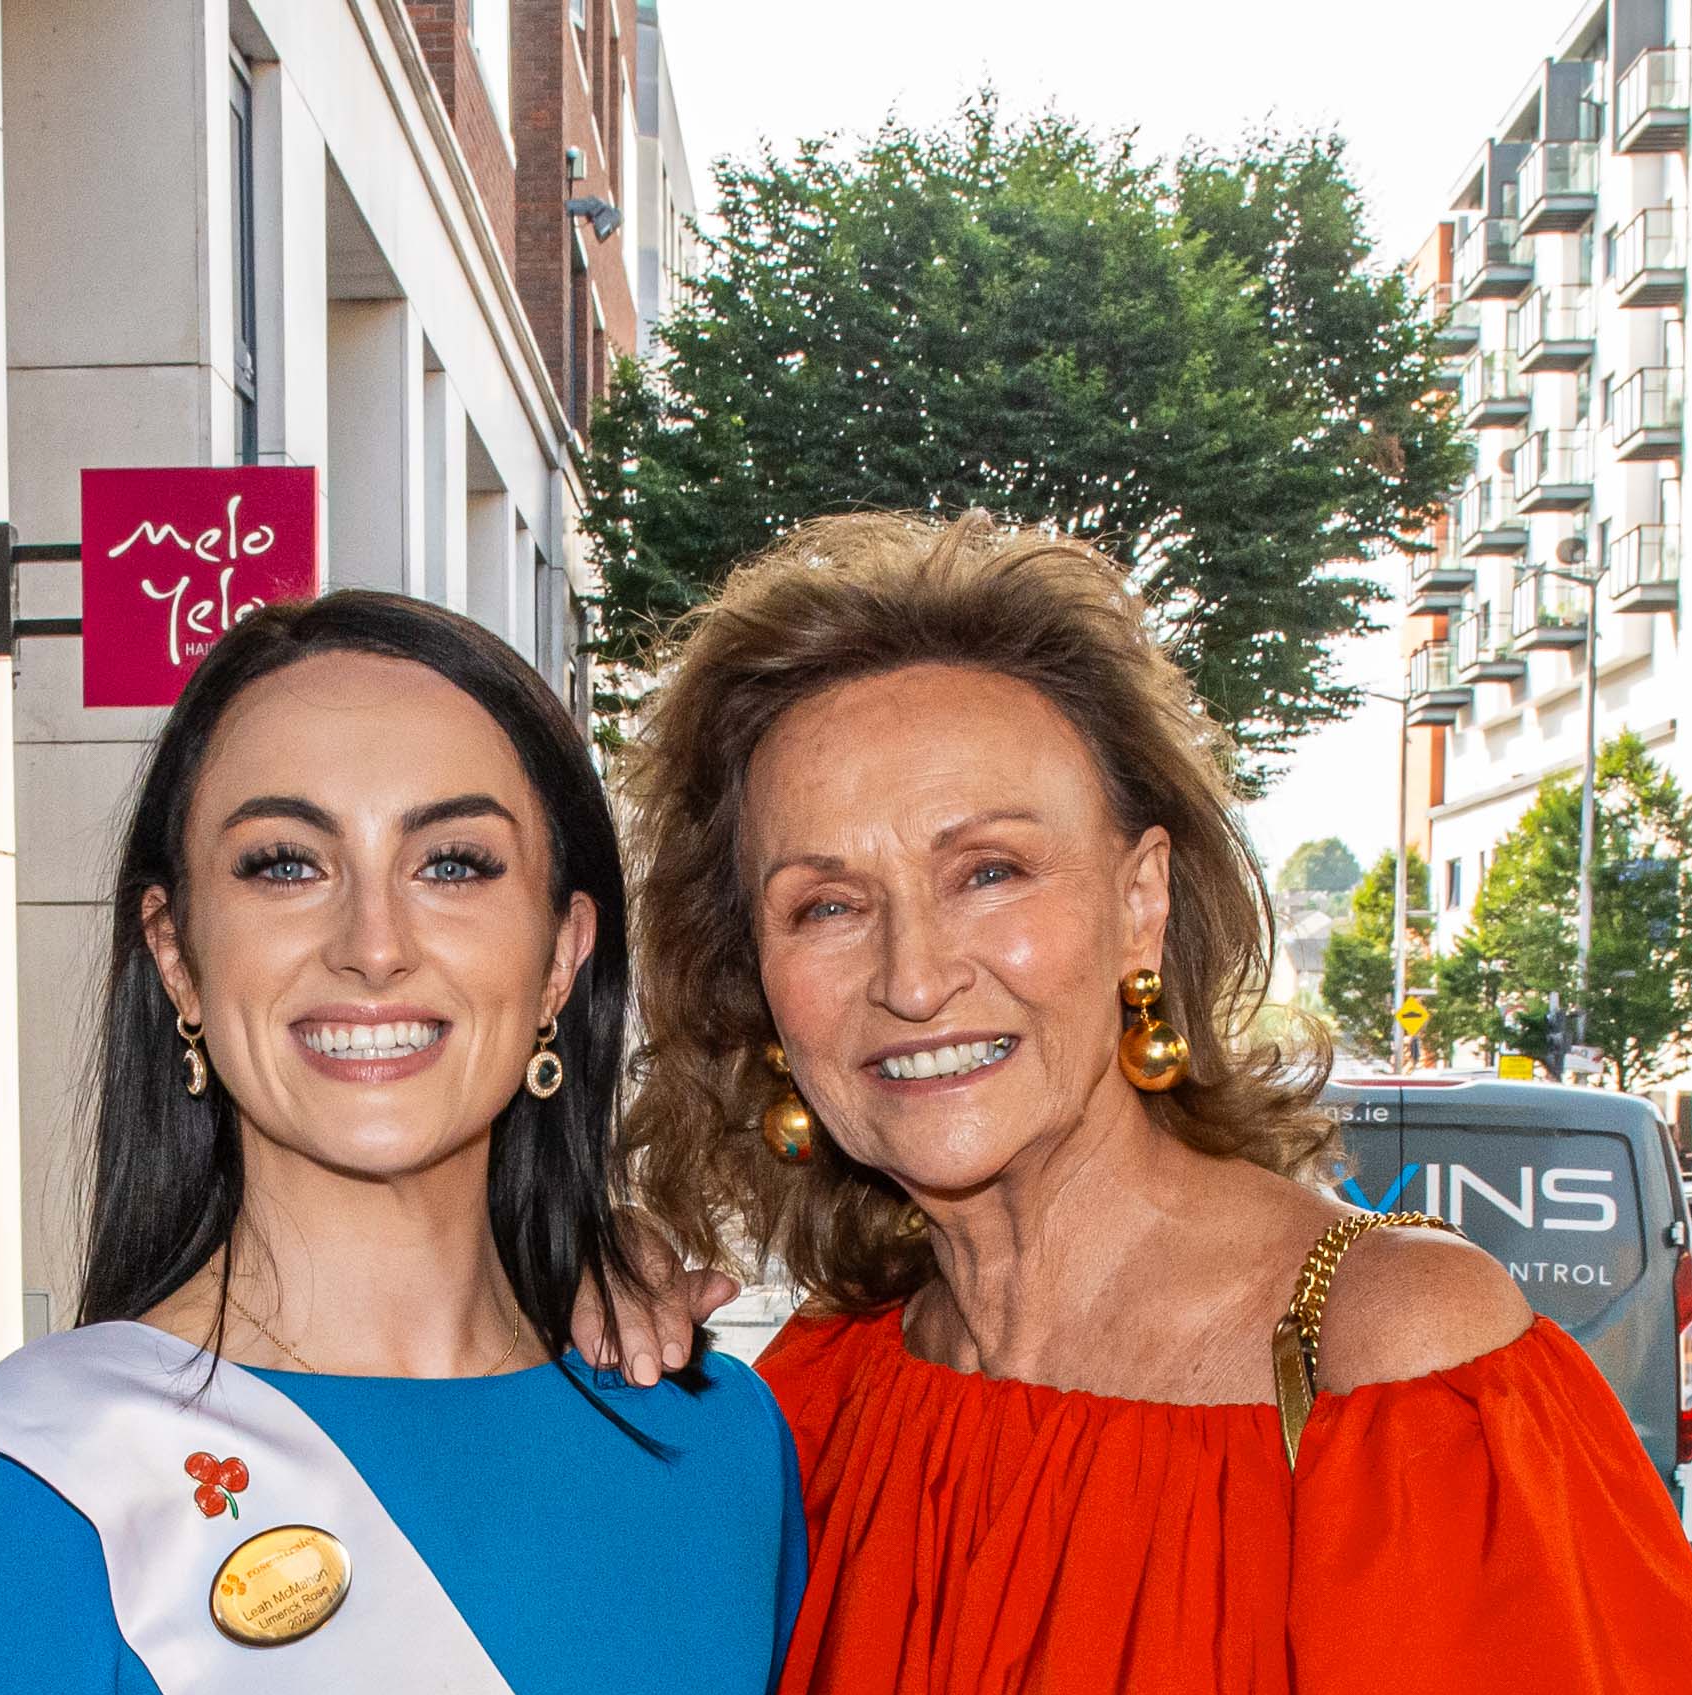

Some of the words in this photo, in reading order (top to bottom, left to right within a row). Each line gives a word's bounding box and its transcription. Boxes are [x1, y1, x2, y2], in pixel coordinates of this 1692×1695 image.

[242, 1599, 273, 1622] Leah
[273, 1568, 329, 1604] McMahon
[301, 1585, 330, 1605] Rose
